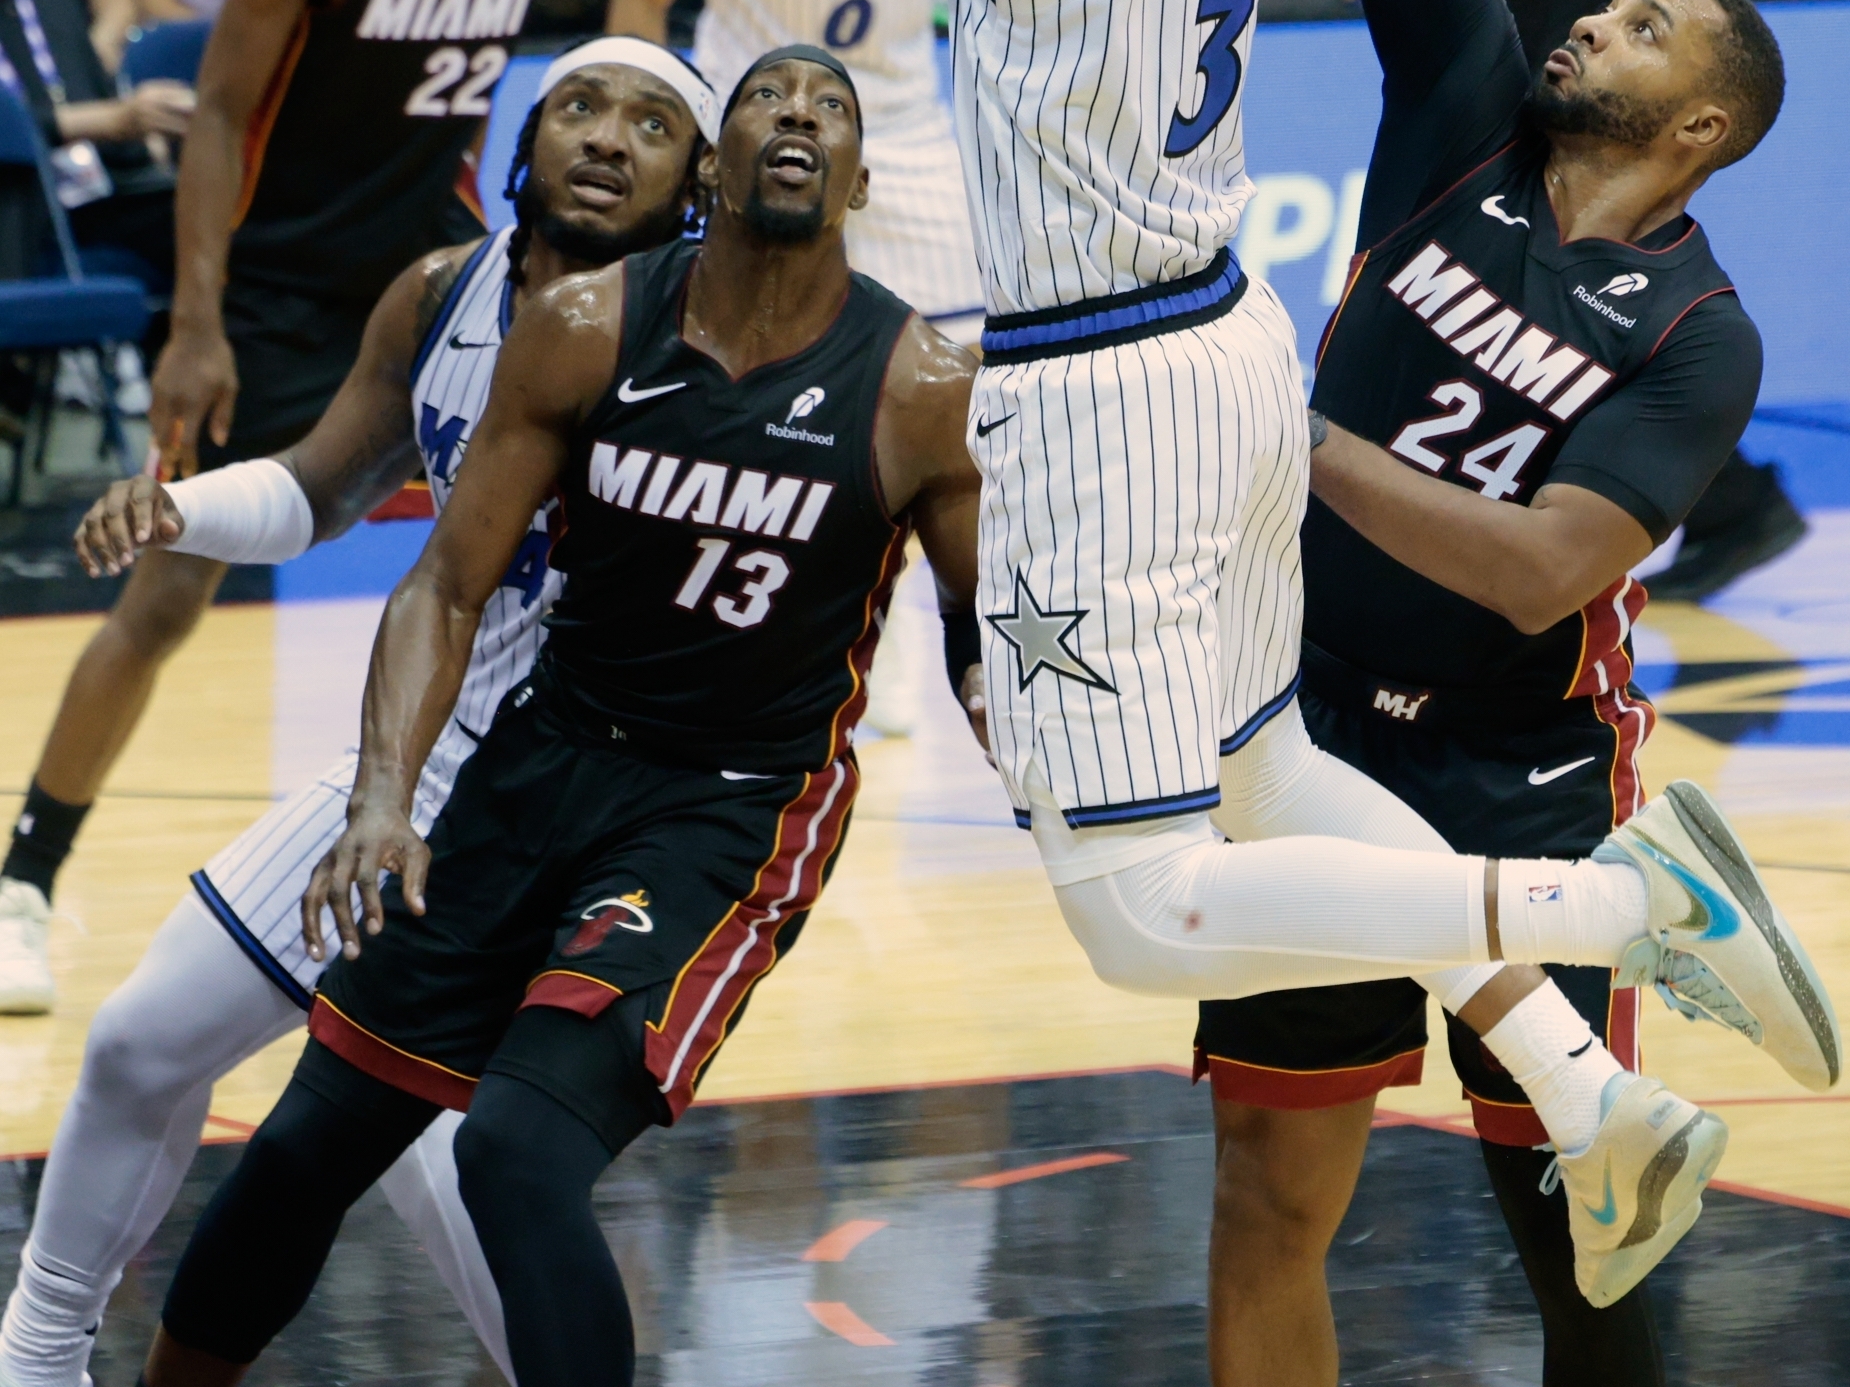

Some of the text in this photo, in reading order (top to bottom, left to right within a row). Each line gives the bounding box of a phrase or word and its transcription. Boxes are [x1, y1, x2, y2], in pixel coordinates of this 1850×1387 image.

[403, 46, 508, 116] 22
[1386, 240, 1615, 423] MIAMI
[1573, 285, 1636, 328] Robinhood
[765, 423, 834, 446] Robinhood
[1387, 378, 1552, 500] 24
[588, 440, 836, 543] MIAMI
[670, 536, 793, 629] 13
